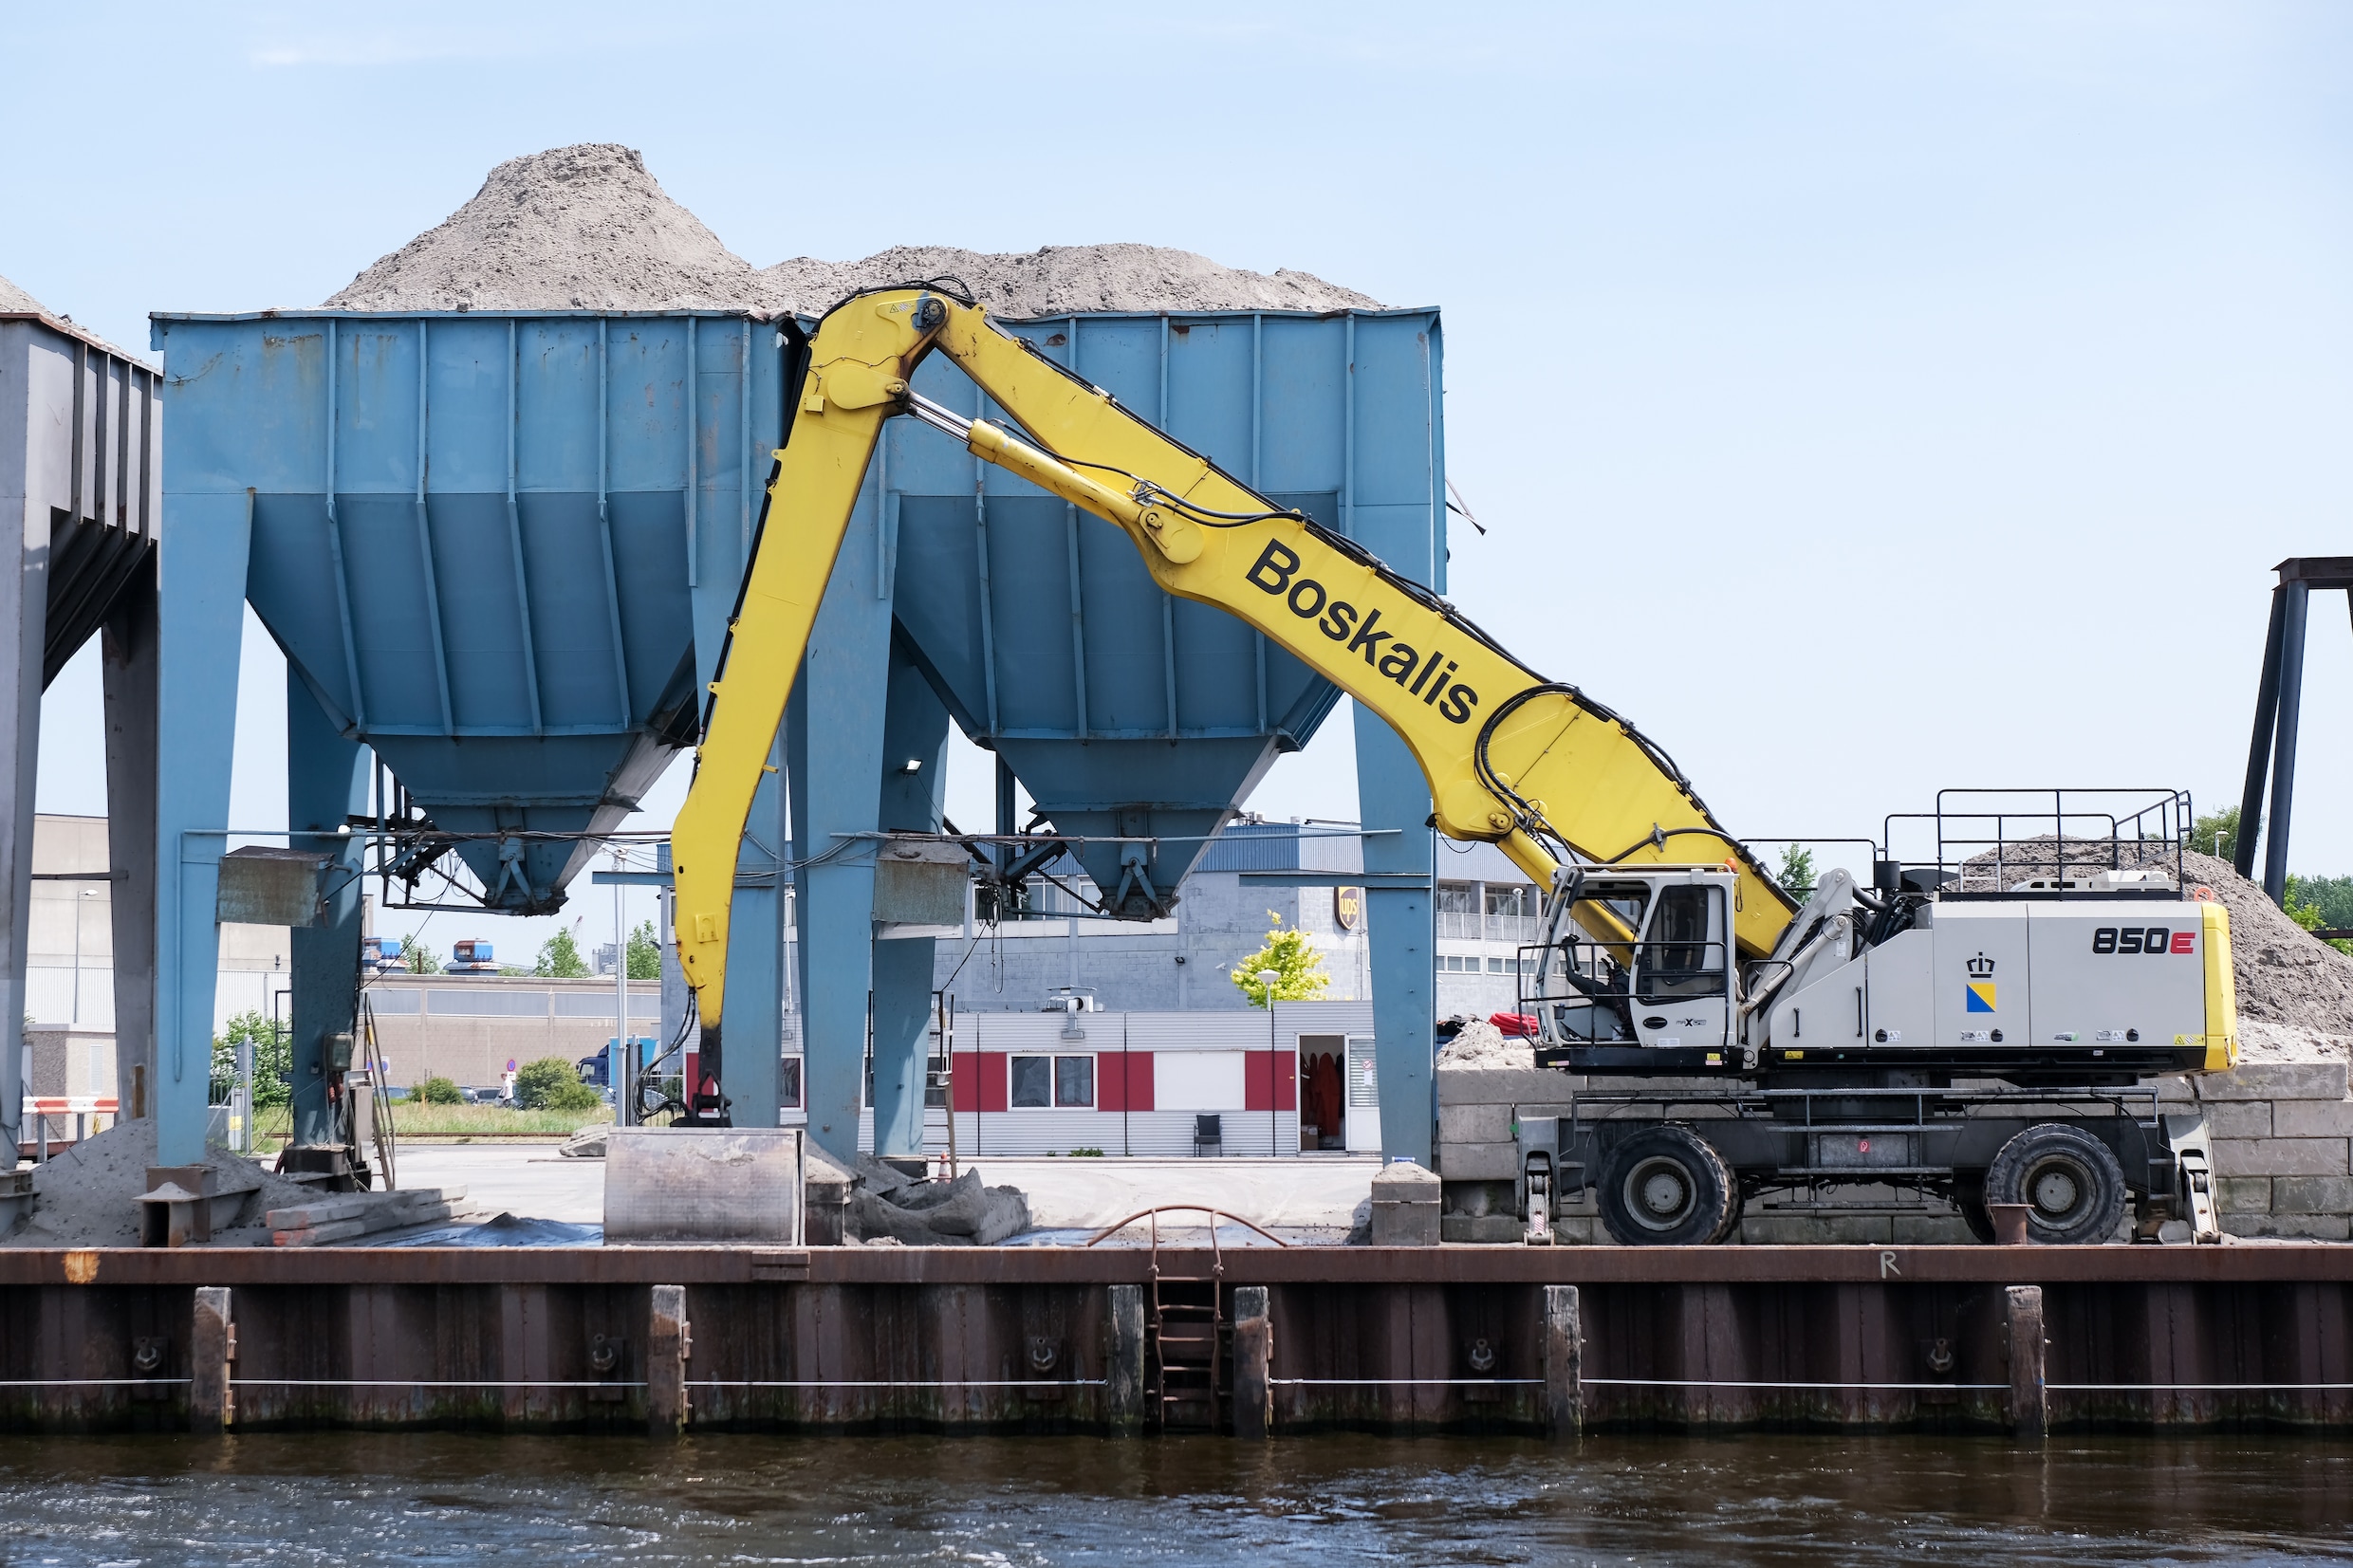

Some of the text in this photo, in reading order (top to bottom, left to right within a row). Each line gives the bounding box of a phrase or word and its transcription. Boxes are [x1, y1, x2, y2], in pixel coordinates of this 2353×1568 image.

[1245, 537, 1478, 725] Boskalis
[1341, 897, 1358, 922] ups
[2092, 928, 2196, 954] 850E
[1880, 1250, 1901, 1280] R
